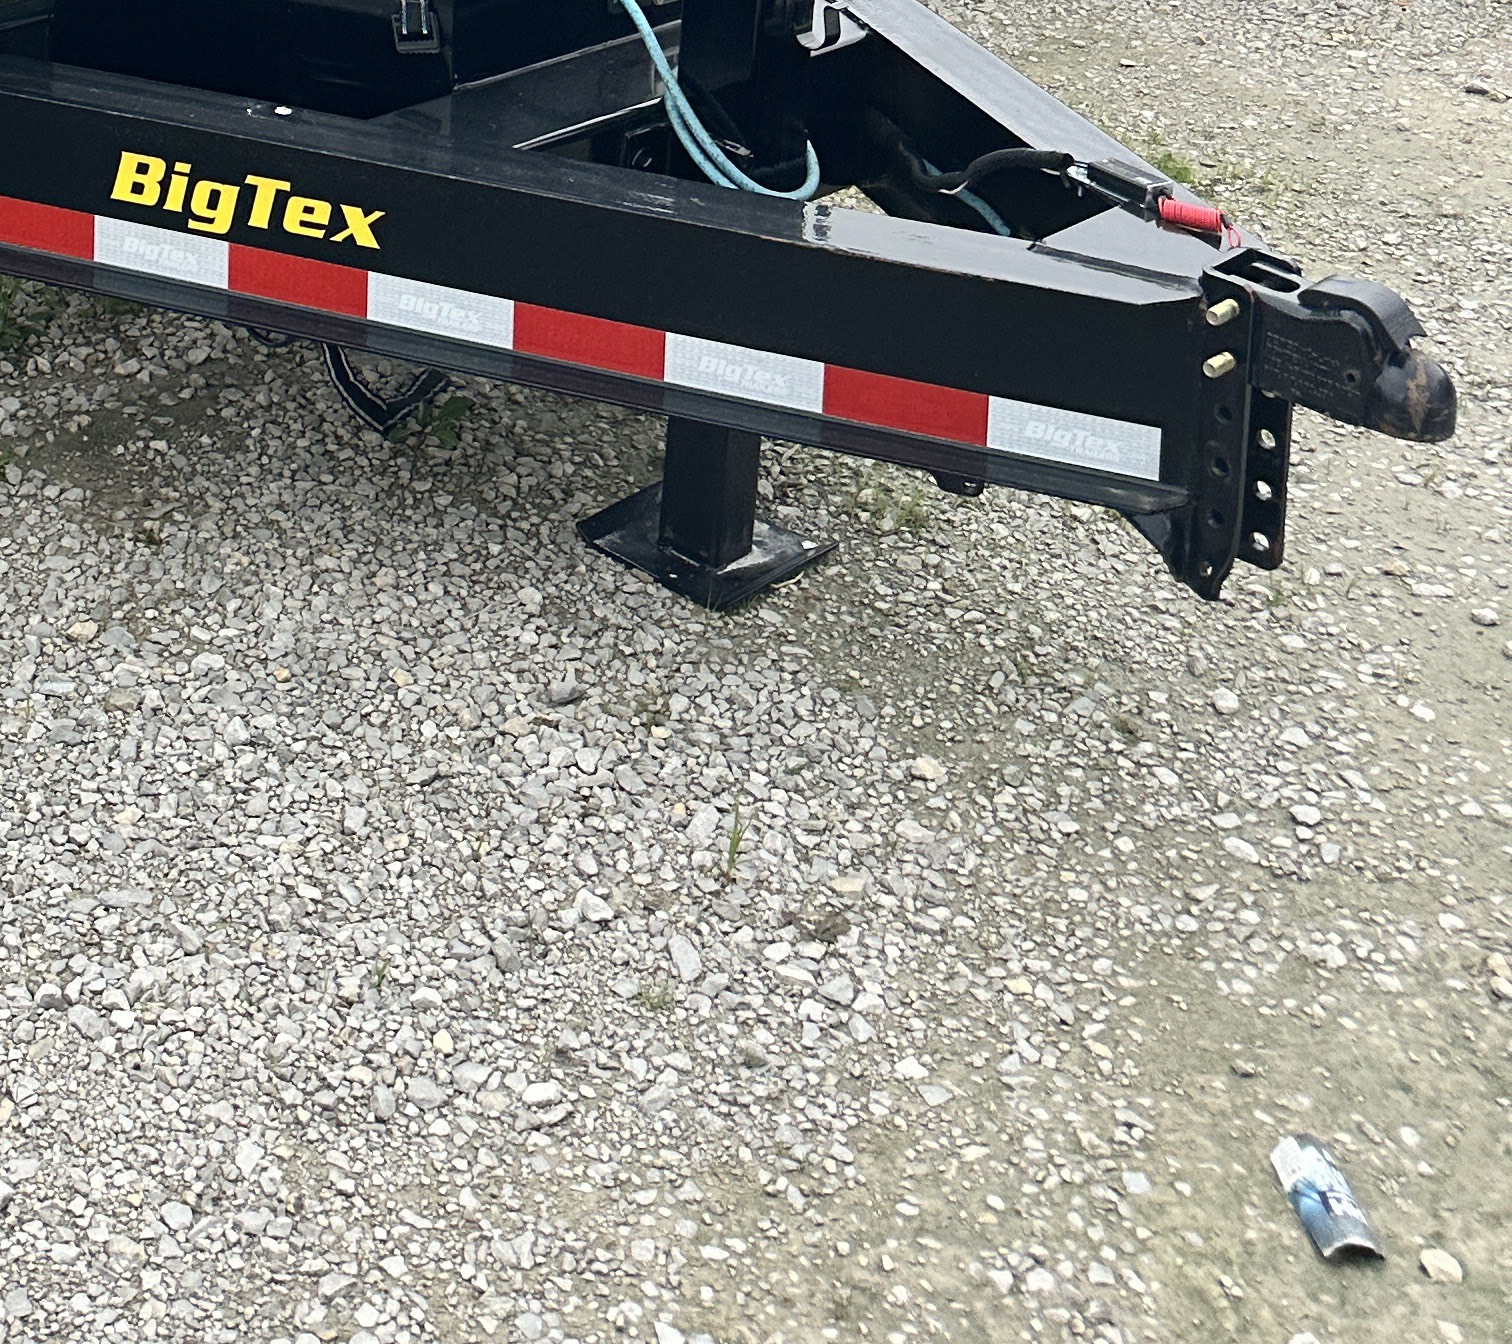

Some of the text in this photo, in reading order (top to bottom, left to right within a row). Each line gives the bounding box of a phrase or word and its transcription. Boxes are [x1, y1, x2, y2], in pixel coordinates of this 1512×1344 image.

[110, 151, 386, 249] BigTex
[123, 236, 199, 268] BigTex
[399, 294, 481, 324] BigTex
[698, 356, 792, 388] BigTex
[1026, 421, 1121, 454] BigTex
